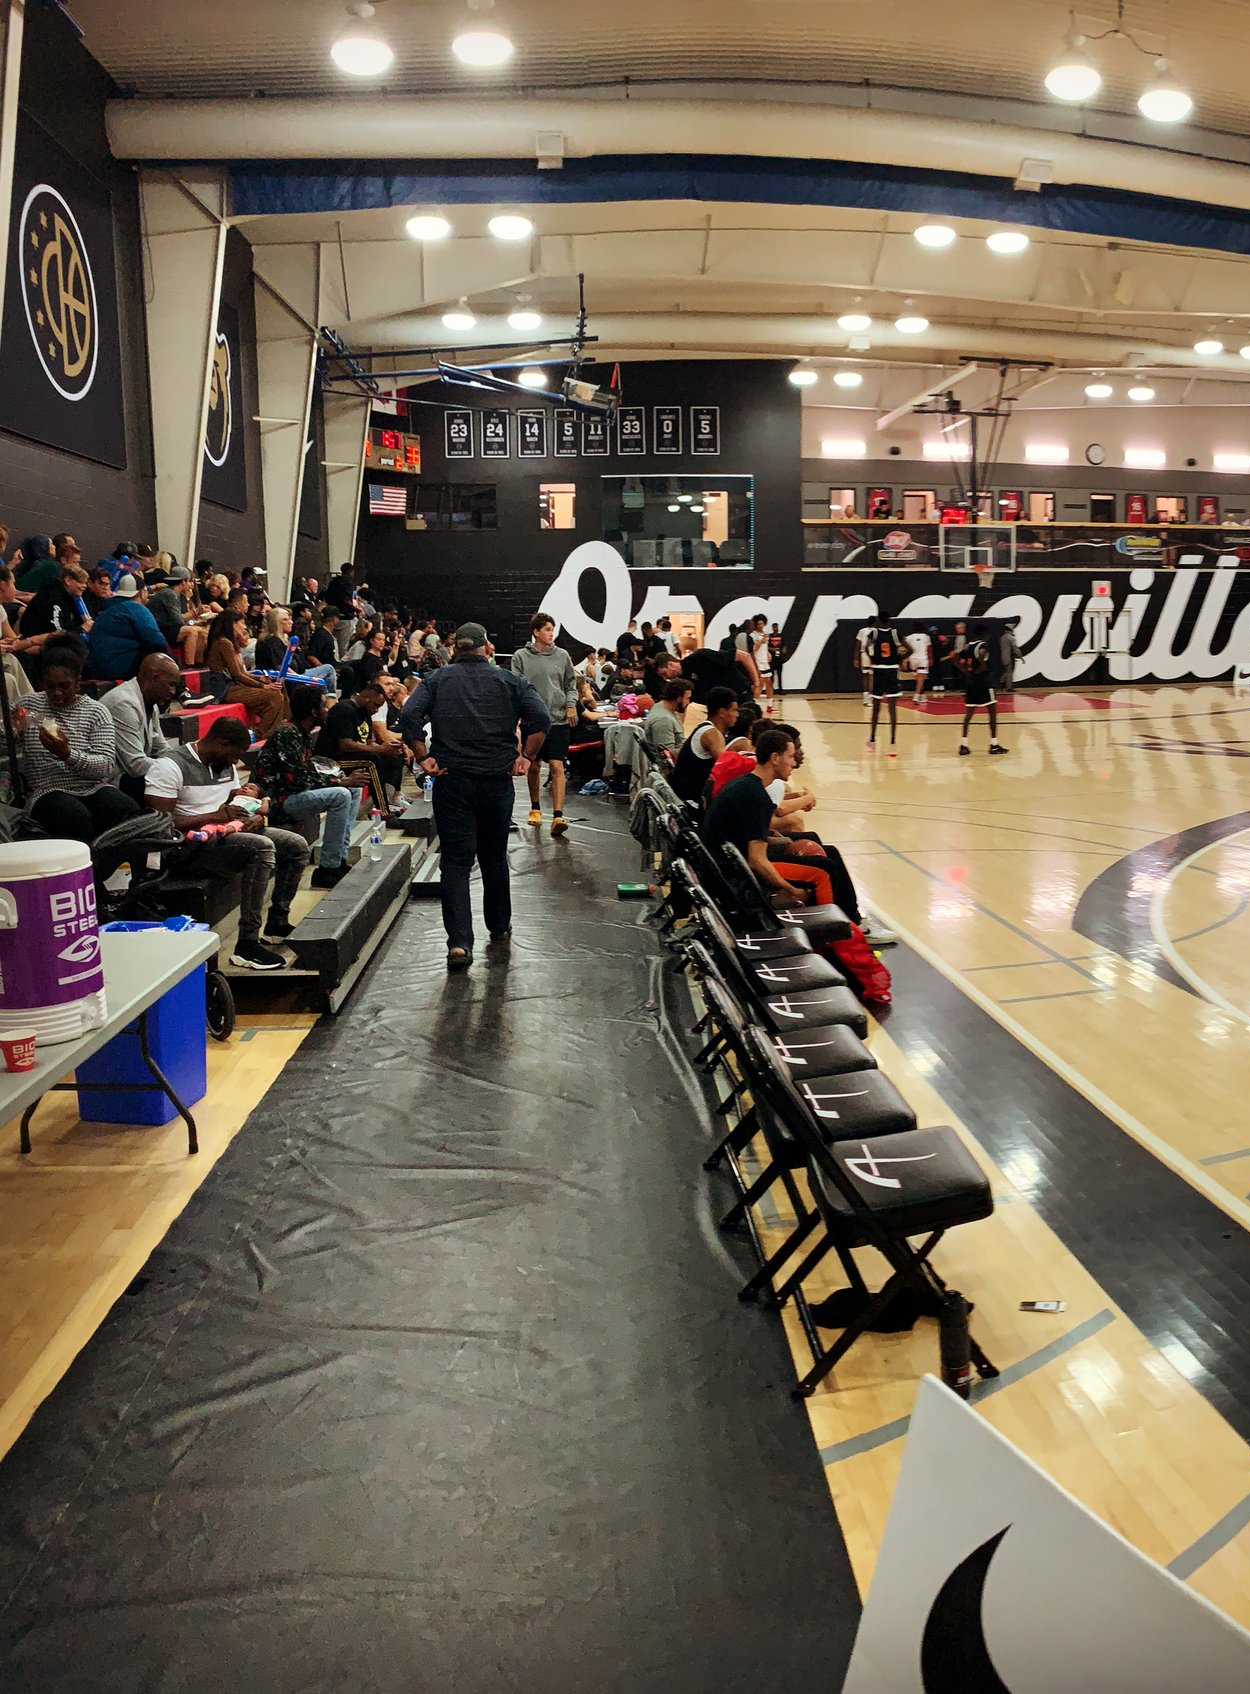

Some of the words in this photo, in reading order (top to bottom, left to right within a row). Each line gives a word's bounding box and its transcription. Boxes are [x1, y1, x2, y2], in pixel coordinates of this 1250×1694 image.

[450, 424, 467, 437] 23
[486, 424, 503, 437] 24
[525, 423, 539, 436] 14
[564, 423, 573, 435] 5
[589, 423, 603, 435] 11
[622, 421, 640, 433] 33
[663, 420, 672, 433] 0
[701, 420, 710, 433] 5
[396, 456, 402, 469] 2
